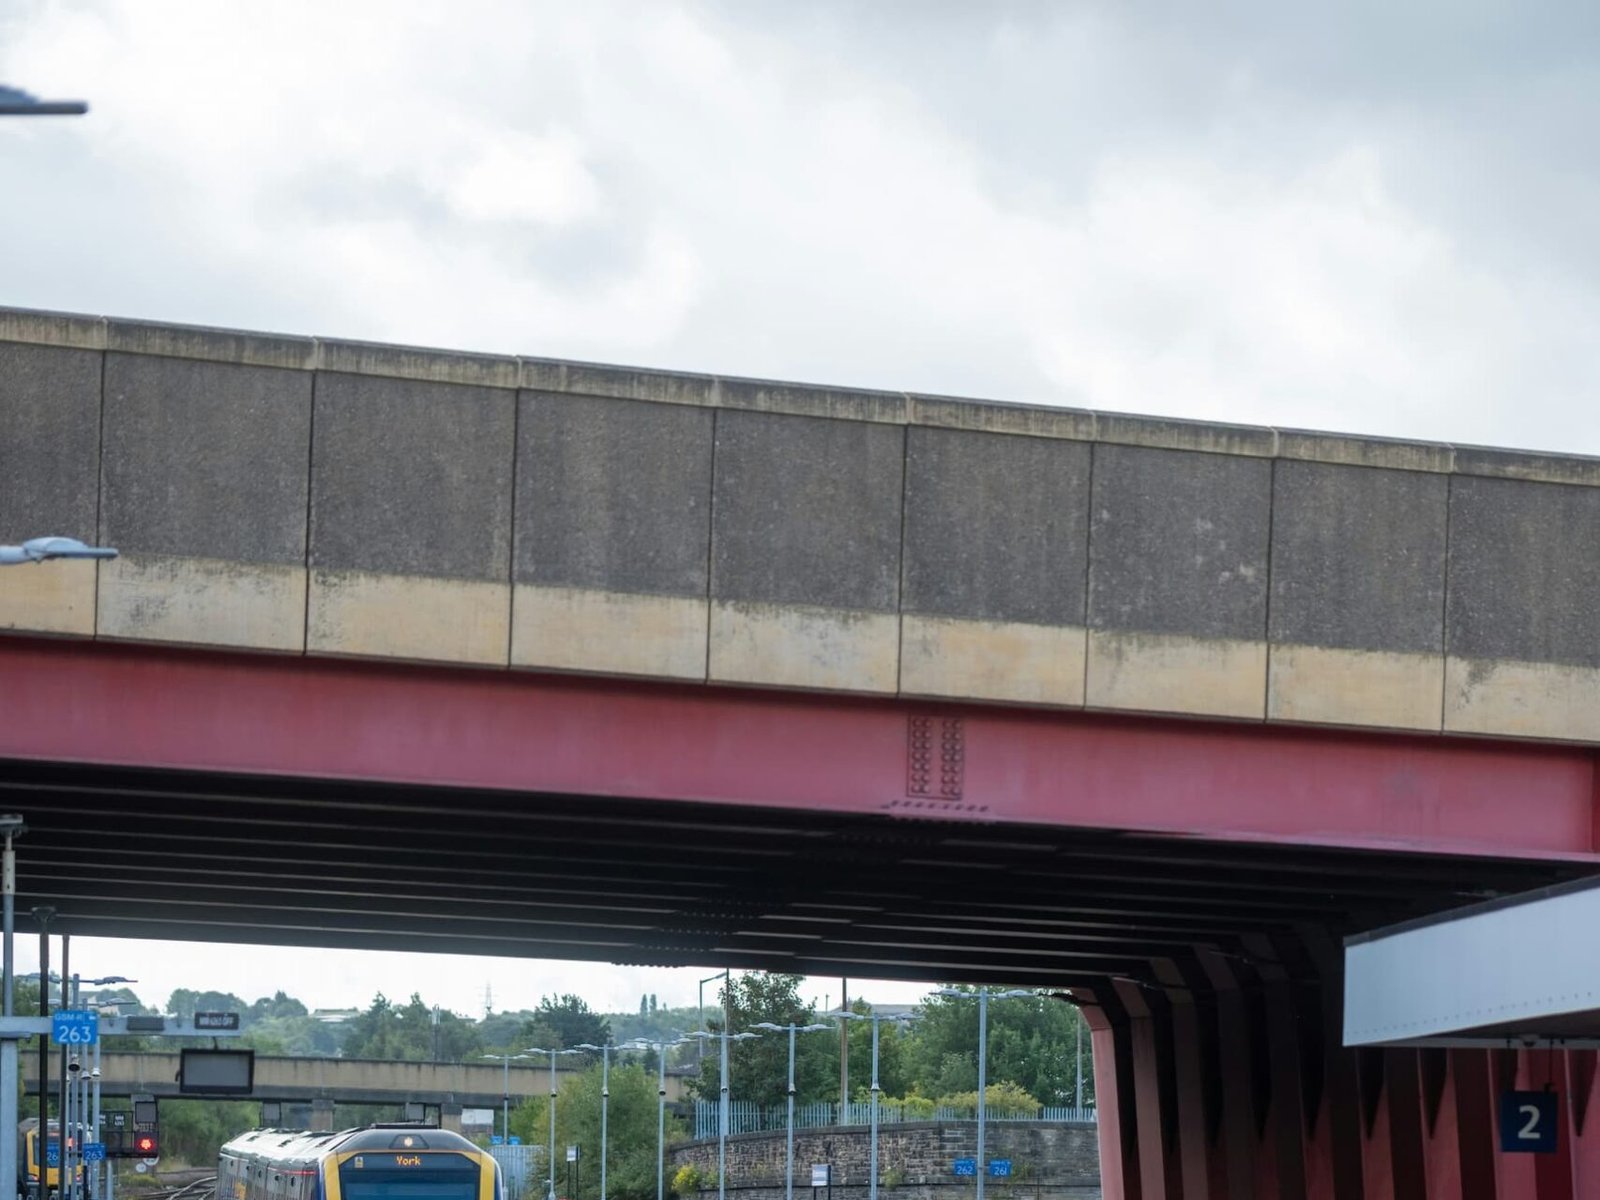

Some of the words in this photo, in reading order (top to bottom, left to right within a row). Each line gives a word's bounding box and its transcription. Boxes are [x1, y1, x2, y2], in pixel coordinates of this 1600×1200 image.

[58, 1025, 92, 1043] 263
[1517, 1104, 1541, 1139] 2
[85, 1150, 104, 1161] 263
[396, 1155, 422, 1166] York
[956, 1165, 974, 1175] 262
[993, 1166, 1008, 1176] 261
